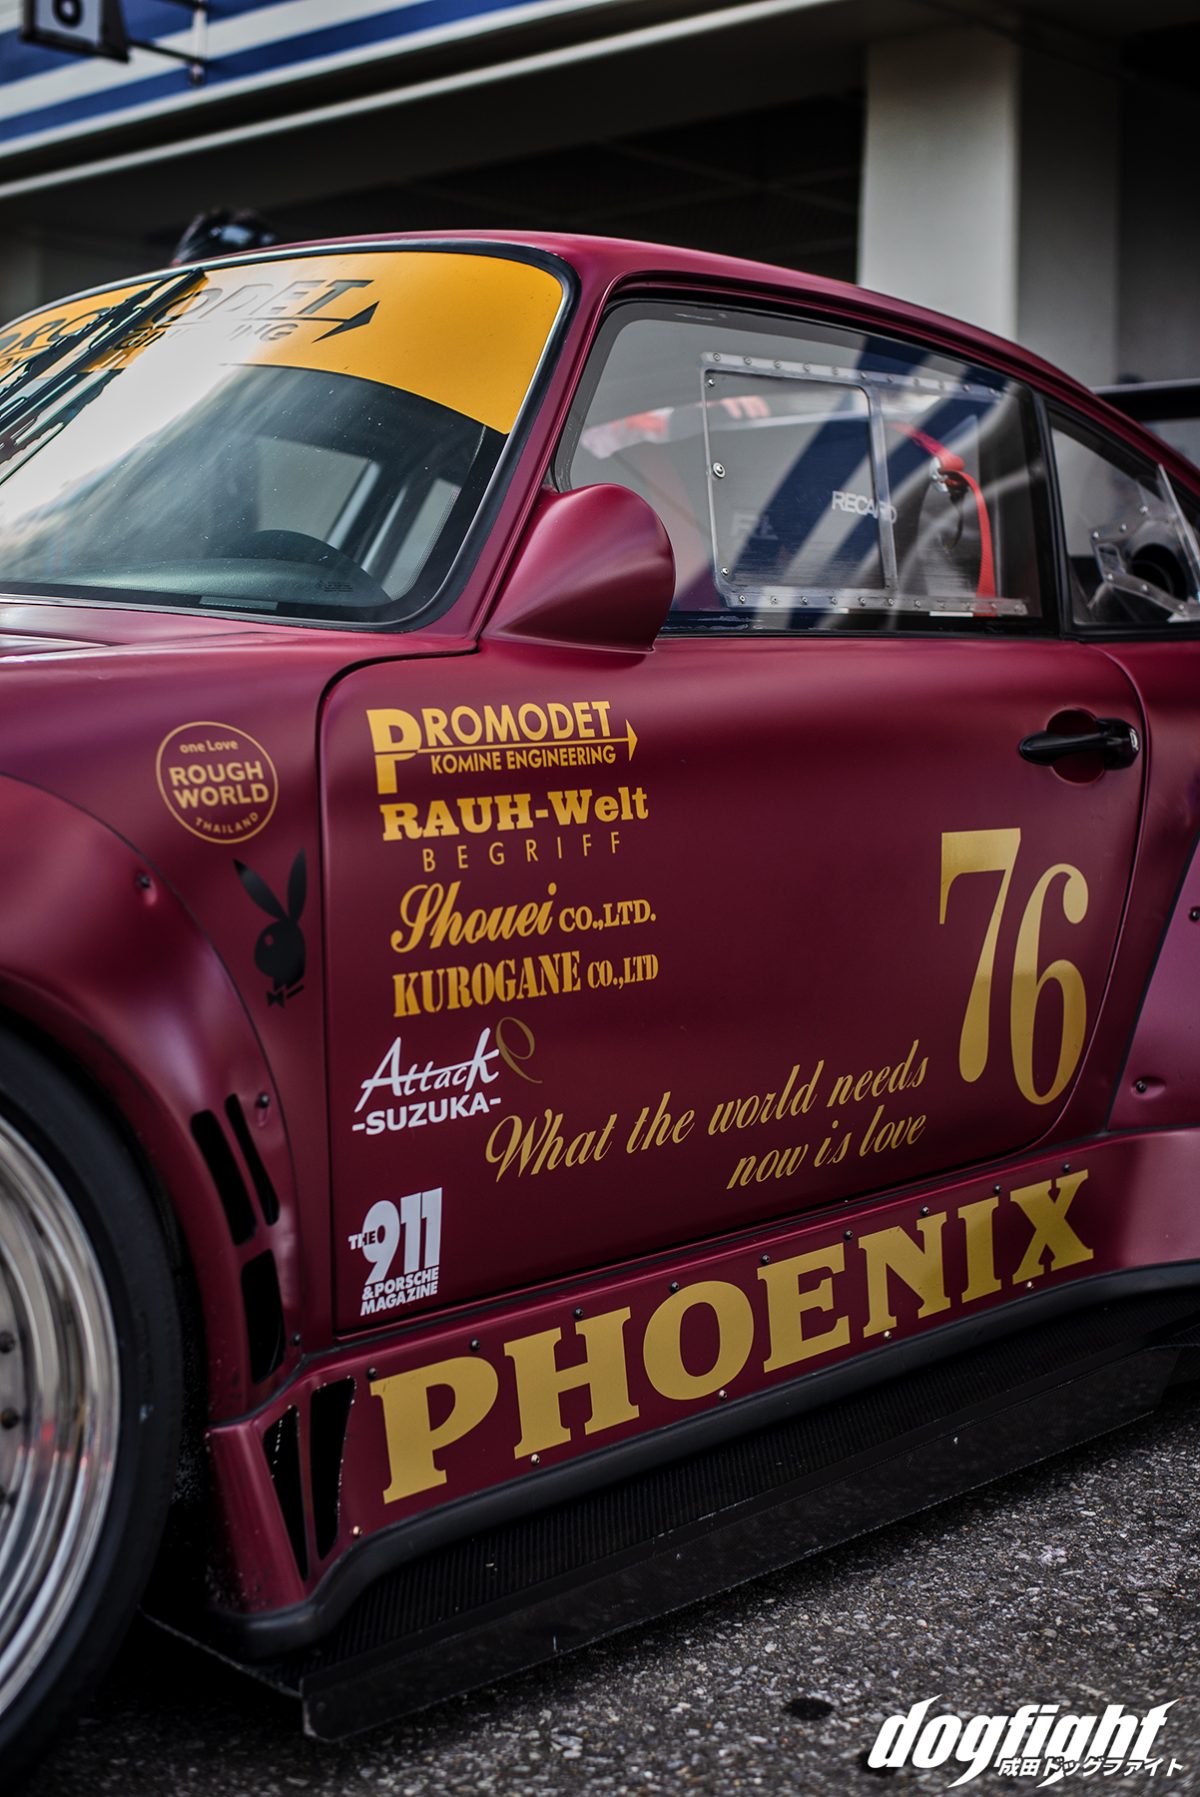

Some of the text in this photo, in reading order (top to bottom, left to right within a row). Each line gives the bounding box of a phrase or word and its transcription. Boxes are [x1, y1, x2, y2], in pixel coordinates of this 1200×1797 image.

[168, 760, 264, 787] ROUGH
[179, 740, 239, 754] one Love
[366, 700, 612, 794] PROMODET
[431, 745, 616, 774] KOMINE ENGINEERING
[173, 783, 270, 809] WORLD
[195, 812, 259, 834] THAILAND
[379, 787, 649, 841] RAUH-Welt
[422, 832, 620, 873] BEGRIFF
[390, 880, 557, 953] Shouei
[393, 951, 581, 1018] KUROGANE
[939, 827, 1089, 1105] 76
[355, 1027, 500, 1112] Attack
[485, 1039, 929, 1182] What the world needs
[726, 1104, 927, 1189] now is love
[347, 1187, 443, 1286] THE 911
[360, 1281, 439, 1316] MAGAZINE
[370, 1169, 1095, 1504] PHOENIX
